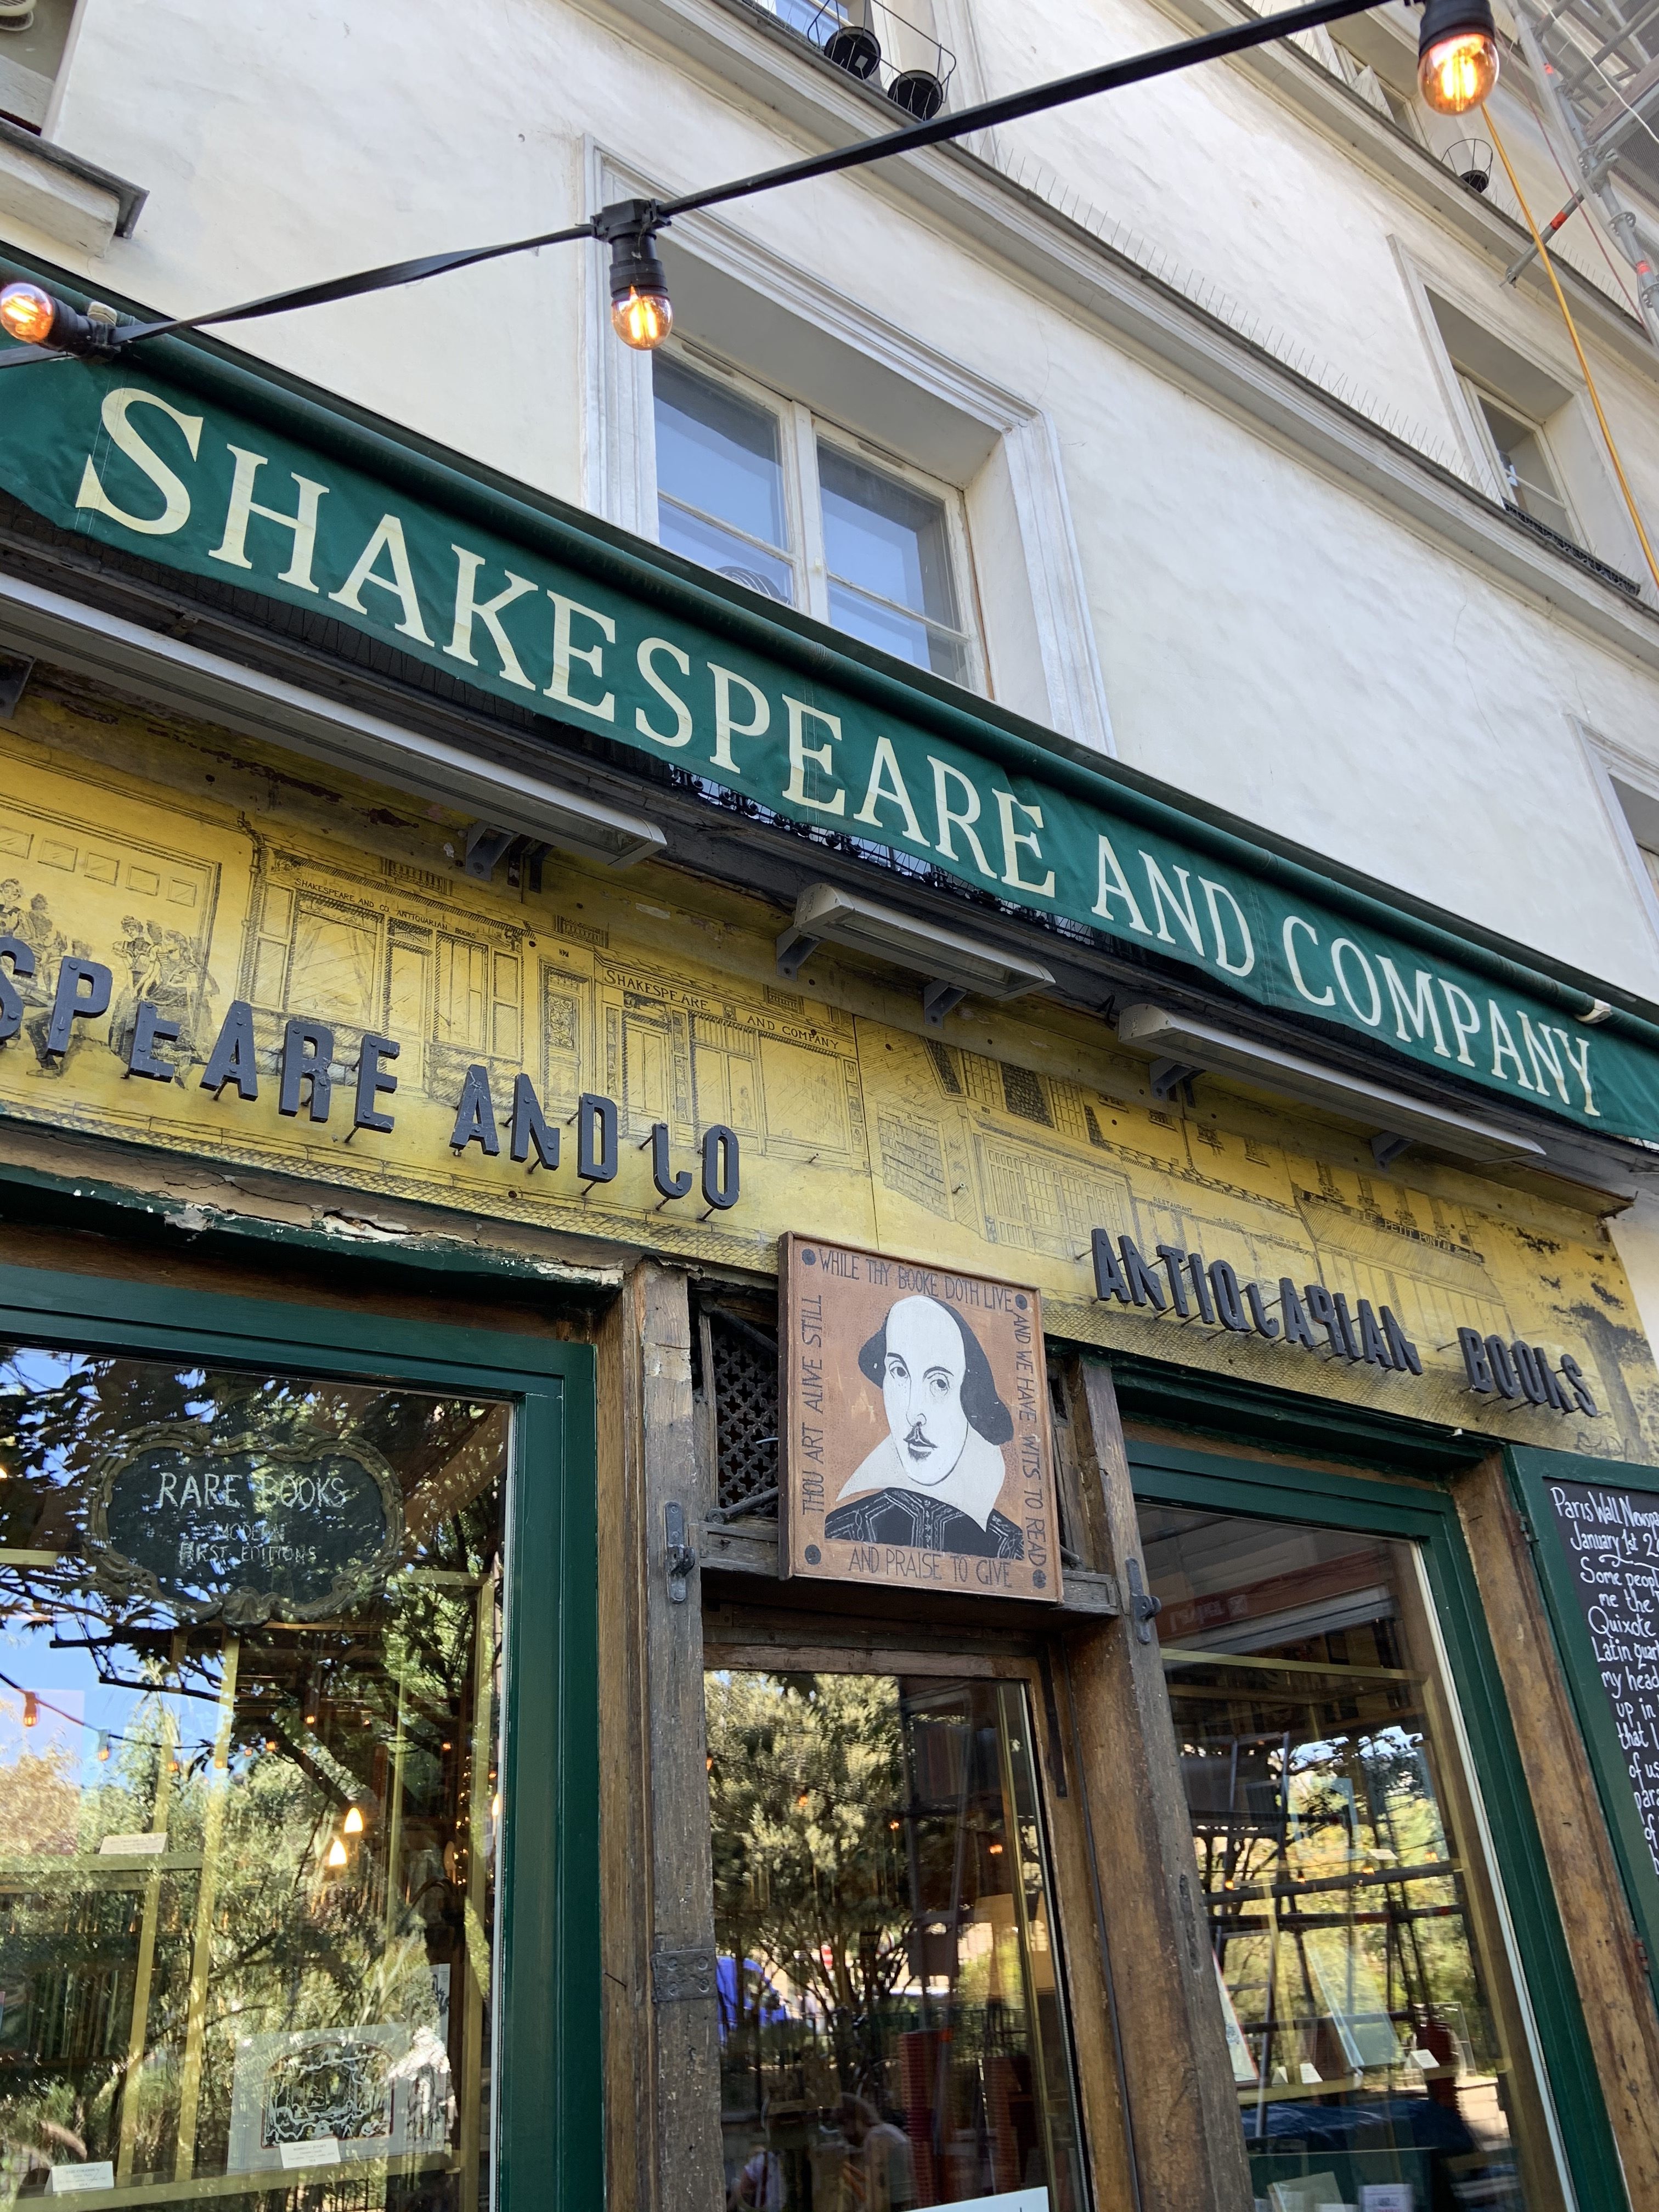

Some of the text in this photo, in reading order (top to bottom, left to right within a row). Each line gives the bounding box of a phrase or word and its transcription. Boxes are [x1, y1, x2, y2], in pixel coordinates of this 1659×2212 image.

[75, 387, 1601, 1117] SHAKESPEARE AND COMPANY
[295, 878, 355, 902] SHAKESPEARE
[358, 898, 374, 908] AND
[397, 910, 448, 931] ANTIQUARIAN
[455, 927, 476, 939] BOOKS
[604, 970, 839, 1049] SHAKESPEARE AND COMPANY
[449, 1064, 618, 1183] AND
[1153, 1197, 1193, 1214] RESTAURANT
[1363, 1212, 1378, 1224] LE
[1384, 1220, 1415, 1238] PETIT
[1418, 1232, 1442, 1248] PONT
[819, 1248, 1014, 1312] WHILE THY BOOKE DOTH LIVE
[1457, 1327, 1598, 1417] BOOKS
[802, 1295, 825, 1515] THOU ART ALIVE STILL
[1013, 1311, 1047, 1567] AND WE HAVE WITS TO READ
[157, 1471, 347, 1509] RARE BOOKS
[1550, 1486, 1594, 1523] Paris
[1588, 1491, 1623, 1525] Wall
[1570, 1521, 1621, 1567] January
[1621, 1528, 1639, 1555] 1st
[848, 1546, 1013, 1589] AND PRAISE TO GIVE
[1580, 1556, 1623, 1585] Some
[1598, 1593, 1619, 1608] me
[1623, 1588, 1655, 1613] the
[1588, 1606, 1657, 1639] Quixote
[1591, 1636, 1634, 1663] Latin
[1601, 1664, 1659, 1699] my head
[1615, 1701, 1634, 1728] up
[1639, 1697, 1657, 1720] in
[1615, 1721, 1649, 1750] that
[1628, 1751, 1645, 1790] of
[1644, 1813, 1658, 1850] of
